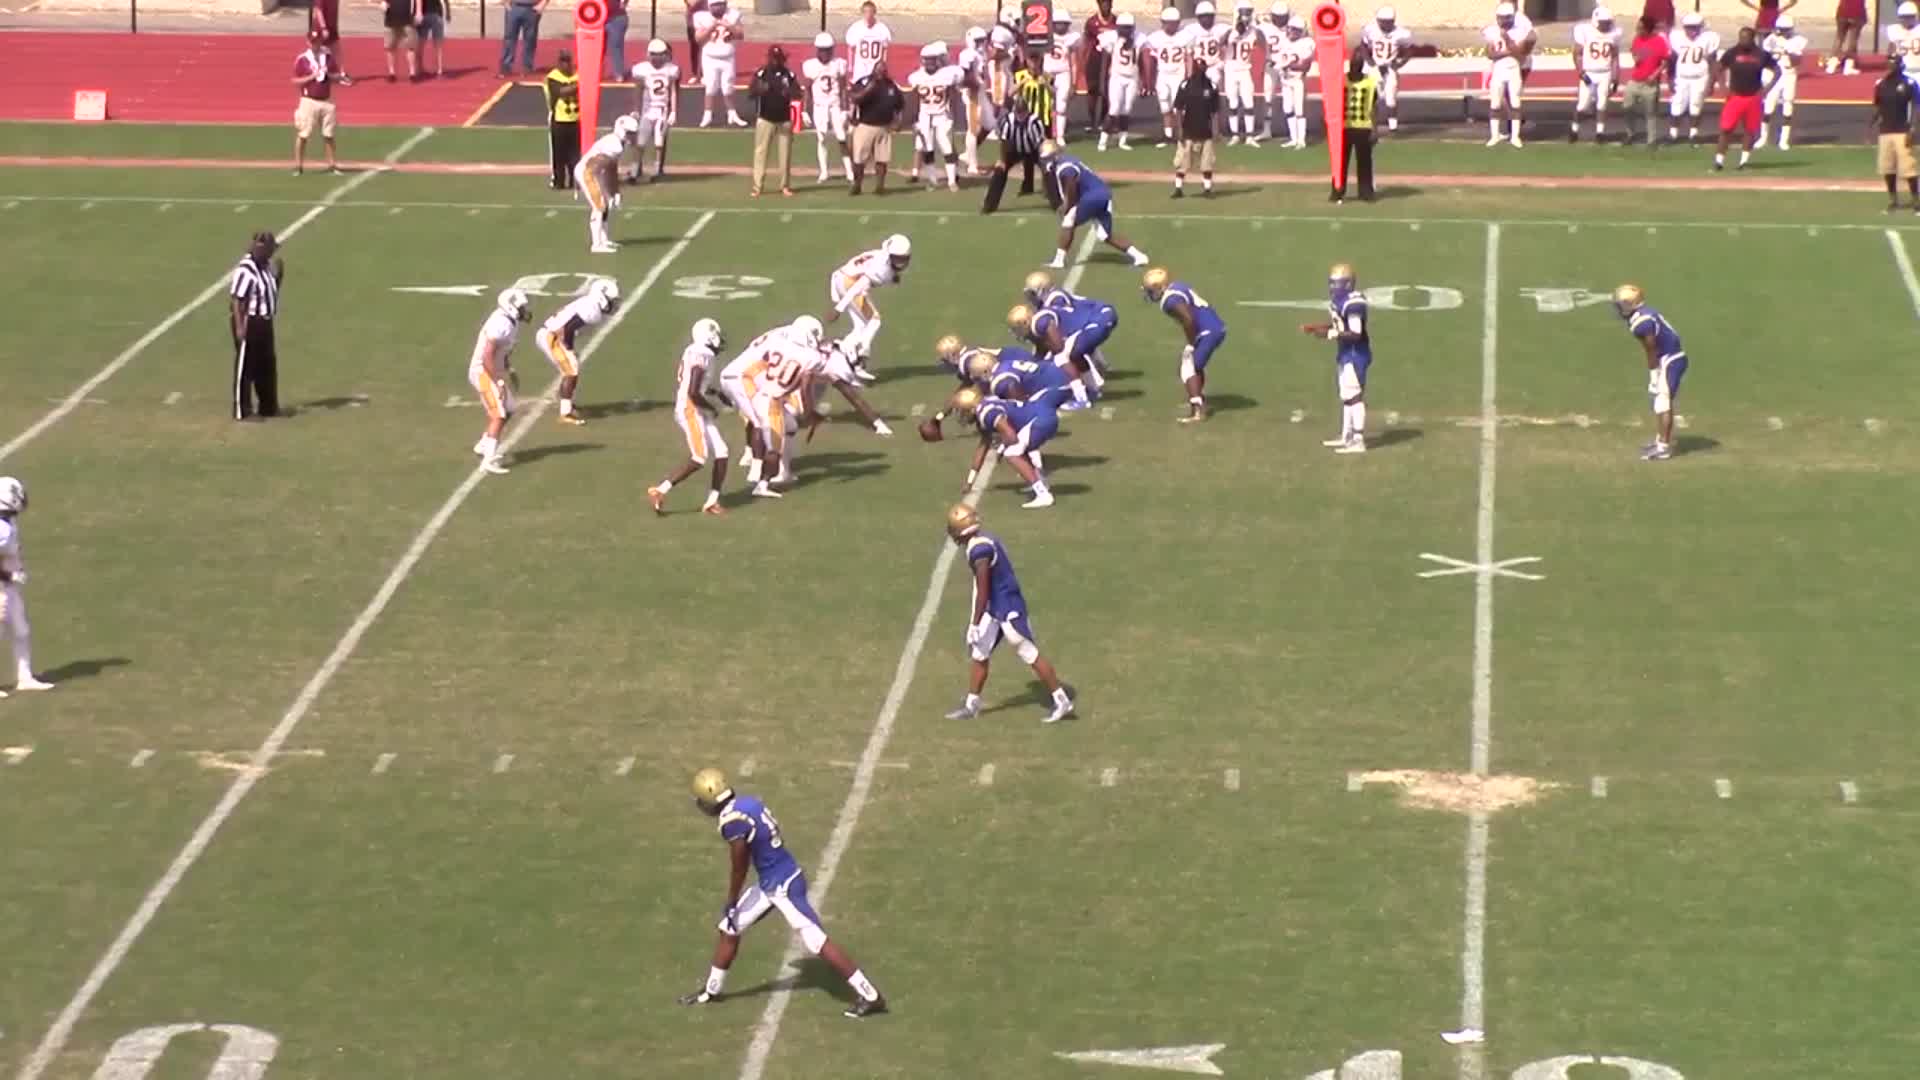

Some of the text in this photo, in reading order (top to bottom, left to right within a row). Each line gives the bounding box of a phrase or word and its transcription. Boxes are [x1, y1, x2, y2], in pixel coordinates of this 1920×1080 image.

[1026, 4, 1049, 34] 2
[859, 40, 881, 60] 80
[1160, 47, 1183, 63] 42
[1680, 46, 1703, 64] 70
[653, 79, 664, 96] 2
[765, 351, 802, 388] 20
